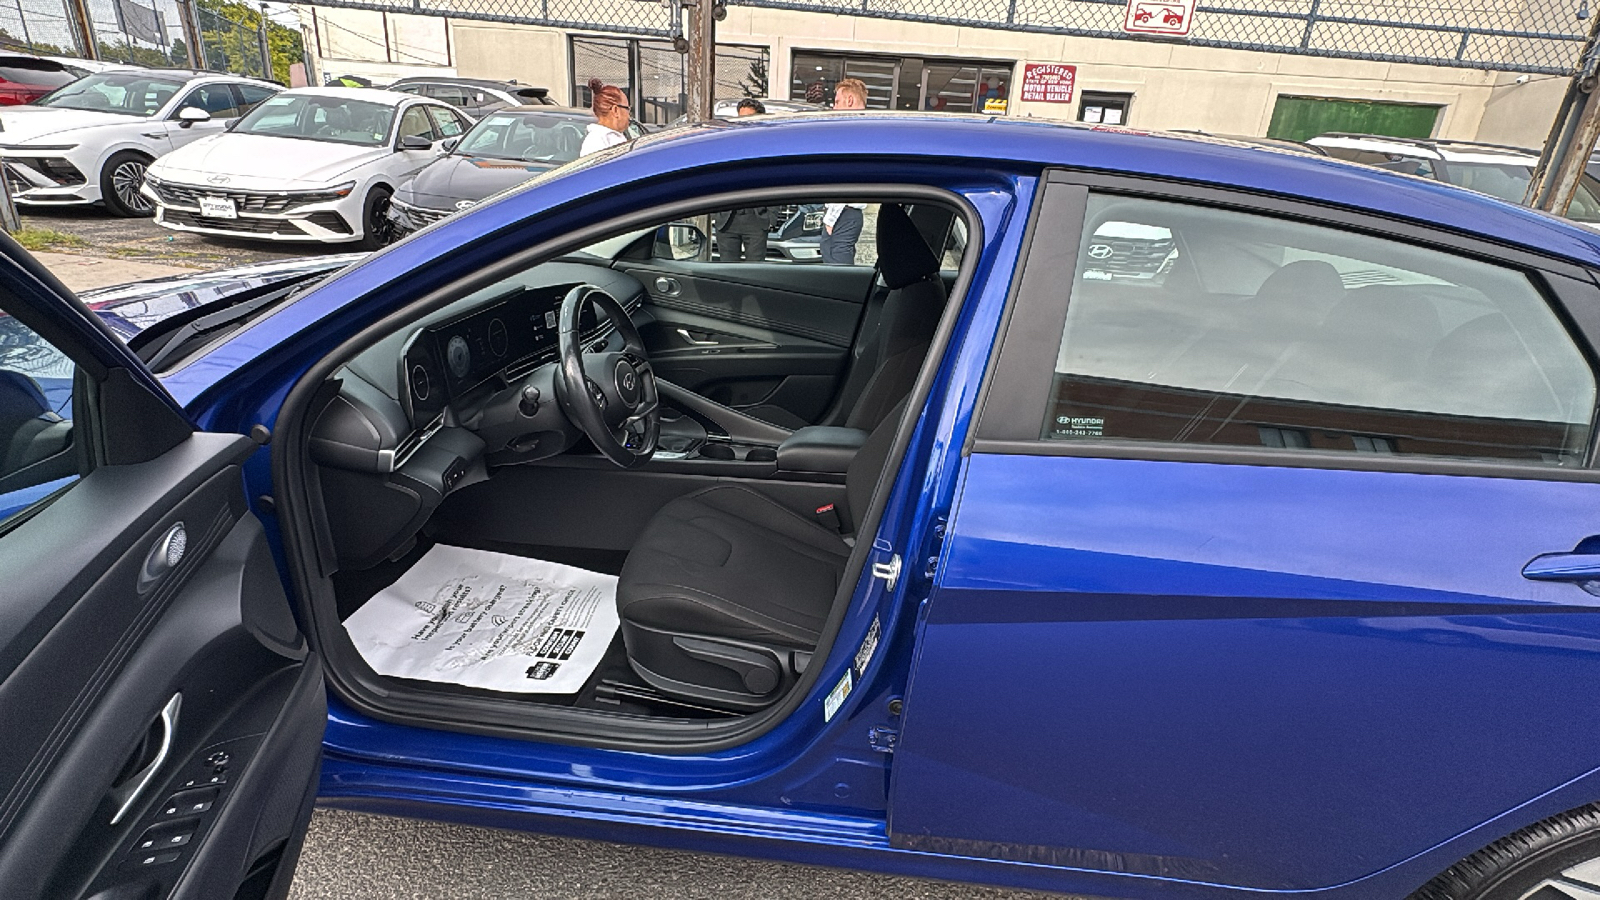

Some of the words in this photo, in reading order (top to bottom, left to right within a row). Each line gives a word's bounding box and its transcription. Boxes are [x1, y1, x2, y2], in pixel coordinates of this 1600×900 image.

[1026, 65, 1073, 80] REGISTERED
[1023, 84, 1045, 92] MOTOR
[1047, 84, 1073, 93] VEHICLE
[1023, 92, 1045, 101] RETAIL
[1046, 93, 1070, 101] DEALER
[452, 586, 472, 611] results?
[411, 625, 430, 640] Have
[452, 584, 463, 598] your
[453, 633, 467, 646] your
[464, 611, 487, 633] battery
[485, 585, 507, 611] charged?
[548, 605, 562, 626] SAFETY
[490, 633, 504, 648] your
